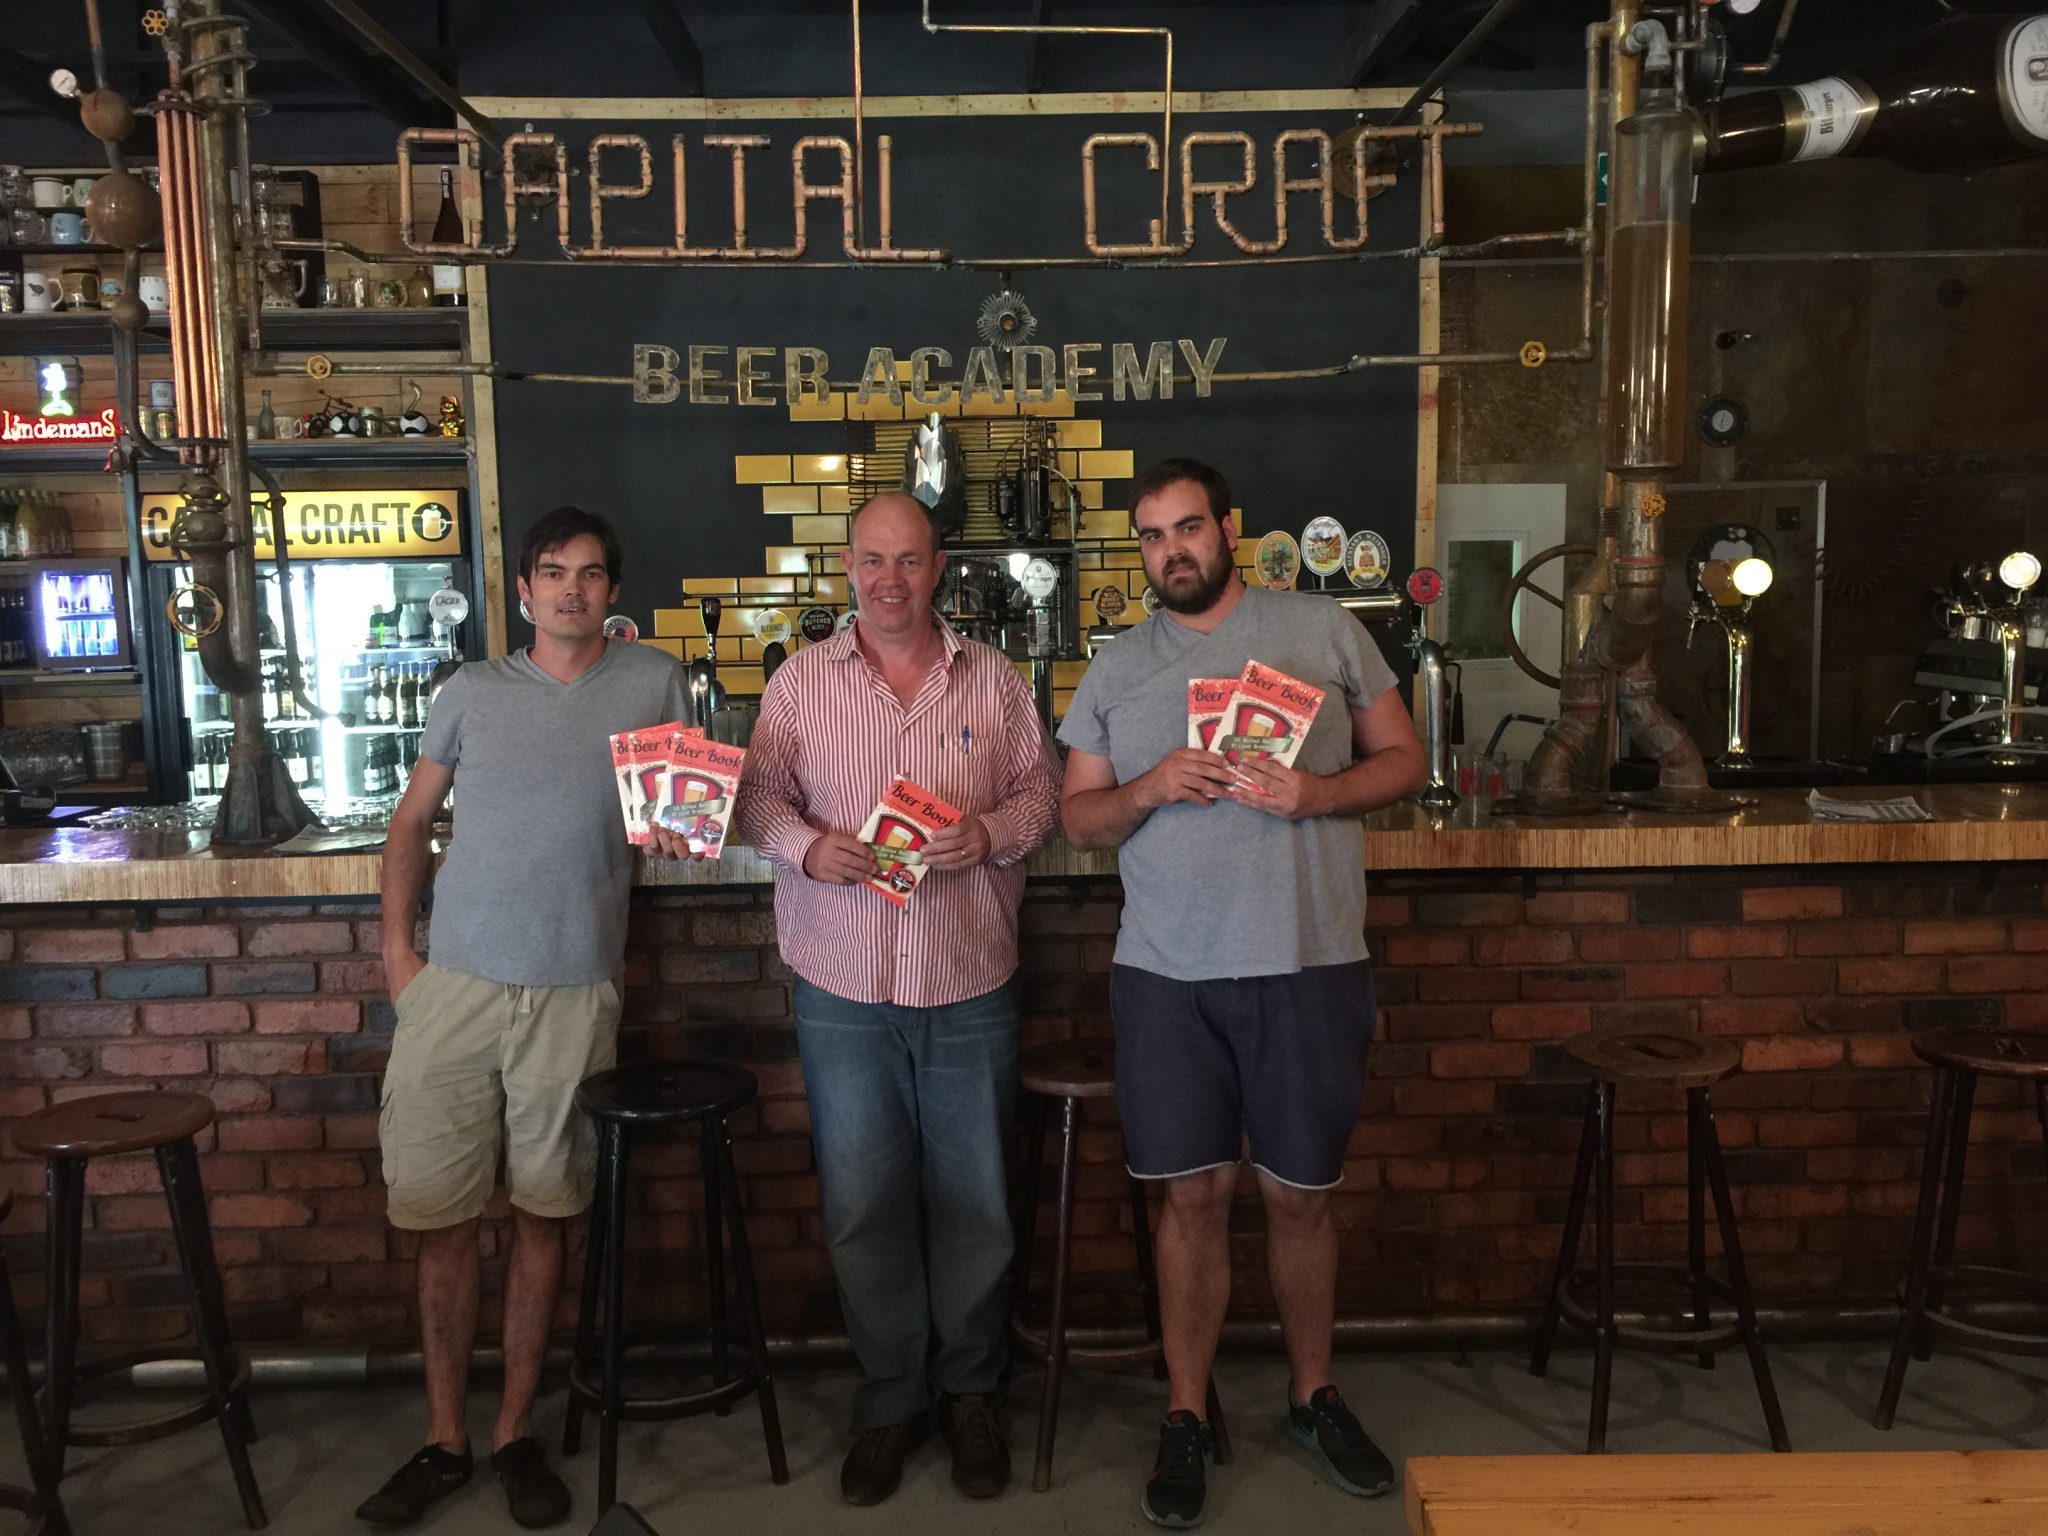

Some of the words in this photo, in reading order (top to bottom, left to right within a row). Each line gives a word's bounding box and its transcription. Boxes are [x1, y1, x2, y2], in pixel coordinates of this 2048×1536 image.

[397, 126, 951, 261] CAPITAL
[1082, 121, 1484, 258] CRAFT
[632, 342, 831, 406] BEER
[855, 336, 1228, 407] ACADEMY
[300, 502, 411, 547] CRAFT
[435, 596, 461, 606] LAGER
[804, 617, 832, 627] BUTCHER
[1192, 685, 1226, 703] Beer
[1246, 667, 1278, 692] Beer
[1280, 684, 1318, 710] Book
[631, 739, 662, 754] Beer
[673, 740, 704, 759] Beer
[707, 748, 742, 769] Book
[891, 783, 922, 807] Beer
